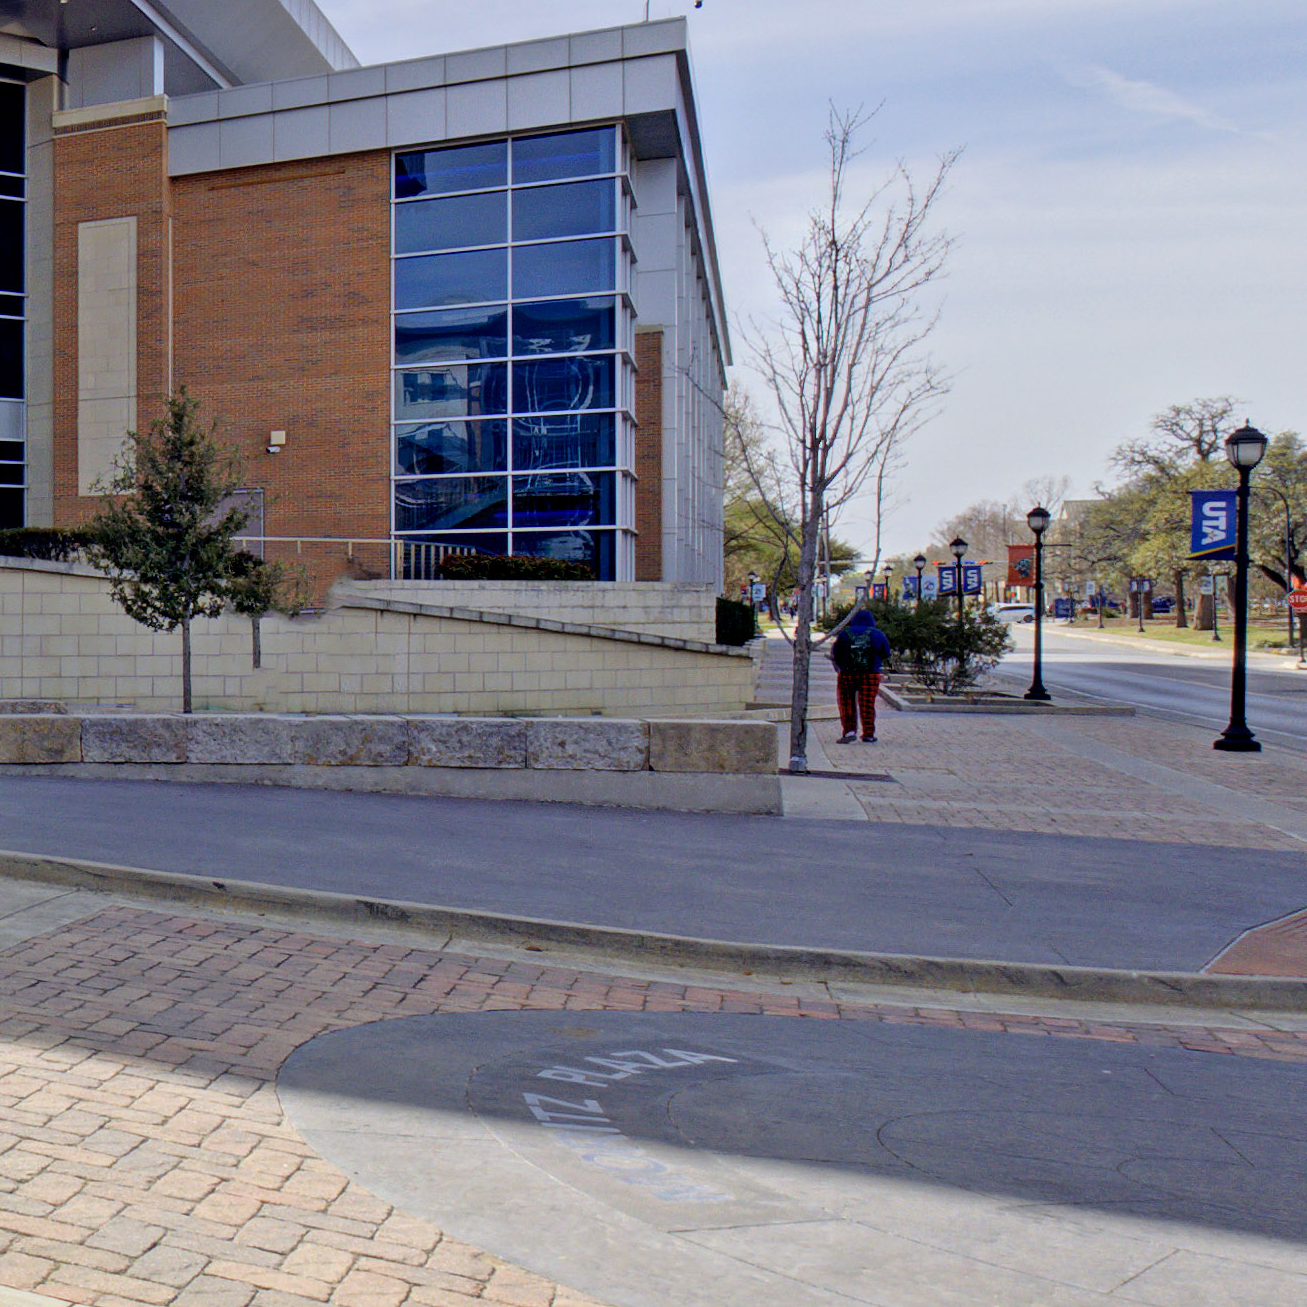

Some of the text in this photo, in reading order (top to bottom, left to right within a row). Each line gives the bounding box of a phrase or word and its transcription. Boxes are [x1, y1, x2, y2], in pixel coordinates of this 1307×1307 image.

[1201, 501, 1227, 545] UTA
[1289, 594, 1307, 603] STO
[537, 1048, 739, 1087] PLAZA
